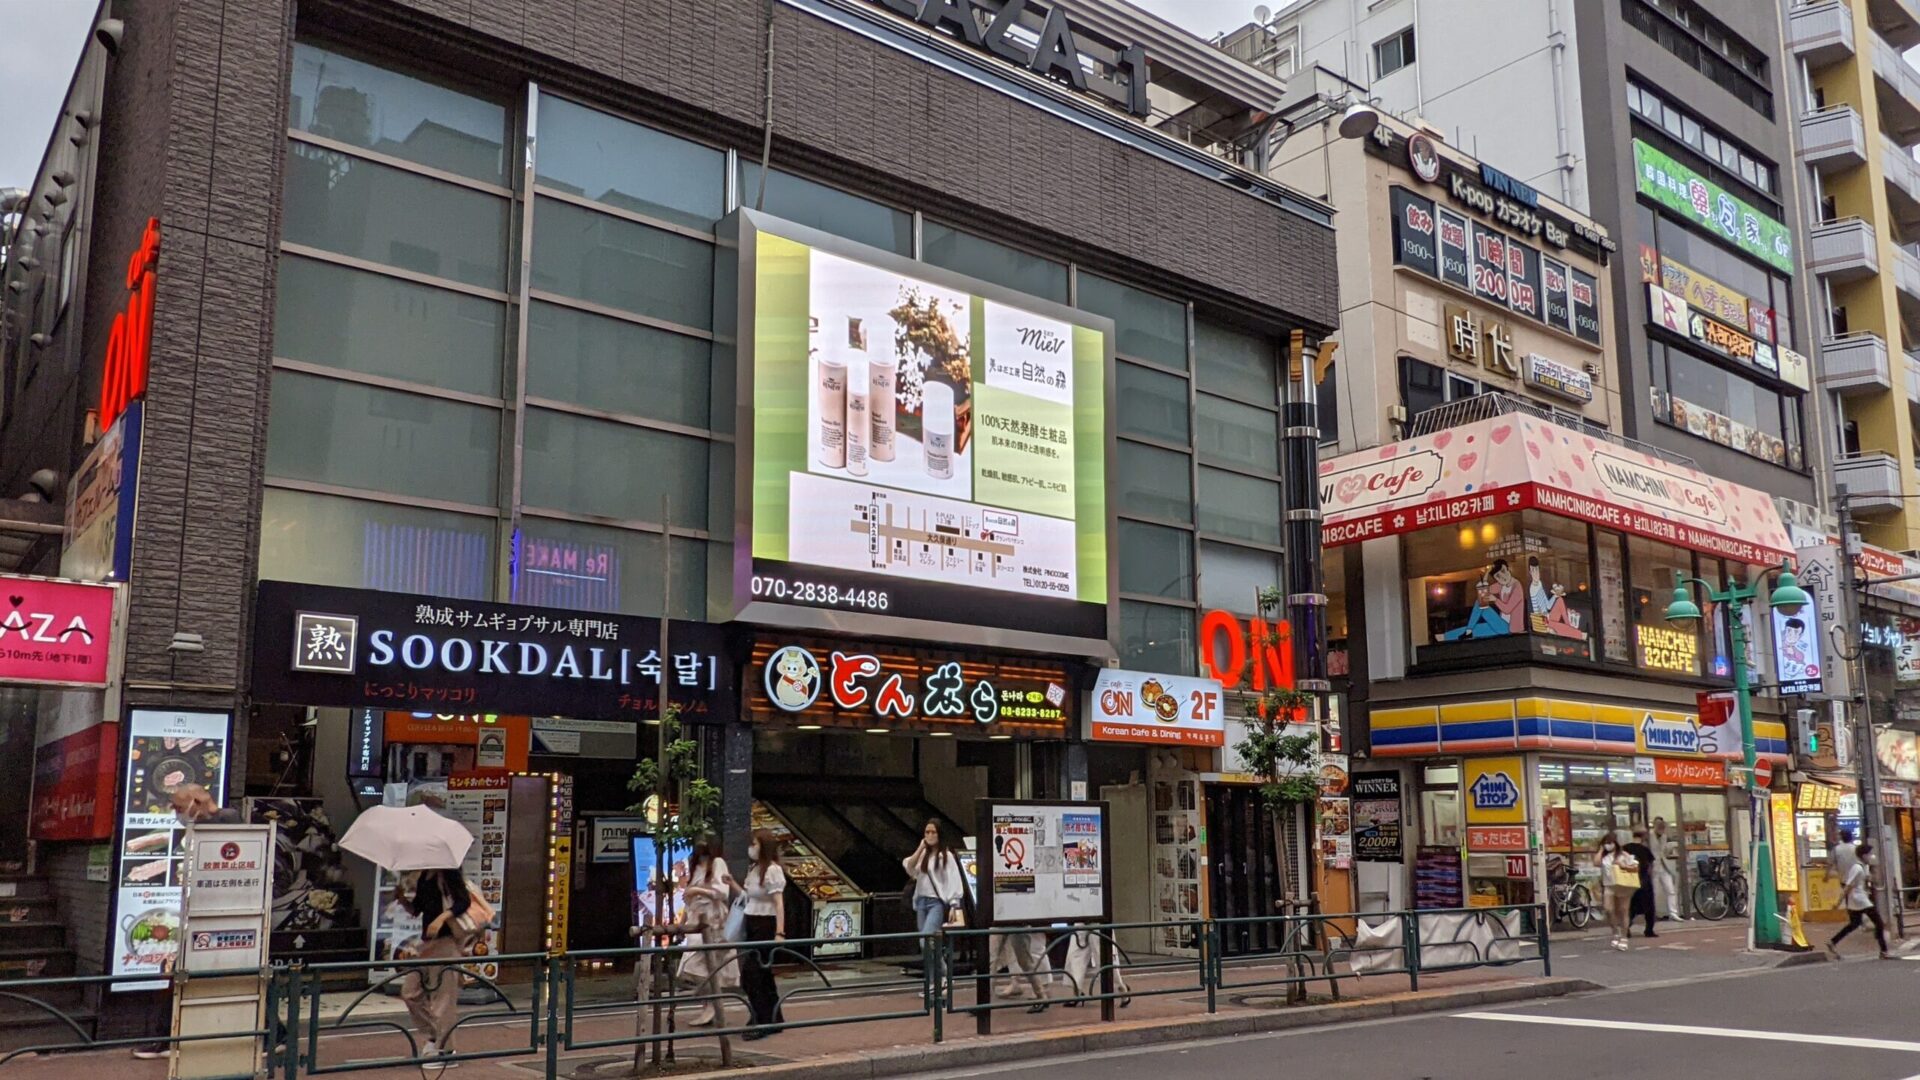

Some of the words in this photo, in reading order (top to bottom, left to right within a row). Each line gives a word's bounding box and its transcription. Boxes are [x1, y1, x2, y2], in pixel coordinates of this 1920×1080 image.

[872, 0, 1089, 91] AZA
[1374, 125, 1393, 147] 4F
[1479, 163, 1538, 208] WINNER
[1451, 173, 1494, 213] K-pop
[1497, 199, 1543, 235] カラオケ
[1545, 219, 1568, 248] Bar
[1368, 466, 1423, 495] Cafe
[1603, 462, 1671, 500] NAMCHINI
[1684, 488, 1716, 516] Cafe
[1537, 488, 1620, 525] NAMHCINI82CAFE
[750, 575, 889, 611] 070-2838-4486
[415, 603, 619, 641] 熟成サムギョプサル専門店
[307, 623, 346, 661] 熟
[1202, 608, 1296, 694] ON
[1637, 625, 1696, 653] NAMCHINI
[369, 629, 613, 681] SOOKDAL
[1644, 647, 1693, 672] 82CAFE
[362, 679, 478, 703] にっこりマッコリ
[1190, 690, 1217, 720] 2F
[1102, 726, 1130, 735] Korean
[1131, 728, 1150, 737] Cafe
[1160, 730, 1182, 740] Dining
[1648, 727, 1670, 744] MINI
[1672, 730, 1695, 747] STOP
[1664, 763, 1721, 779] レッドメロンパフェ
[1355, 783, 1398, 793] WINNER
[1479, 782, 1507, 793] MINI
[1479, 793, 1508, 804] STOP
[1358, 837, 1397, 848] 2,000円
